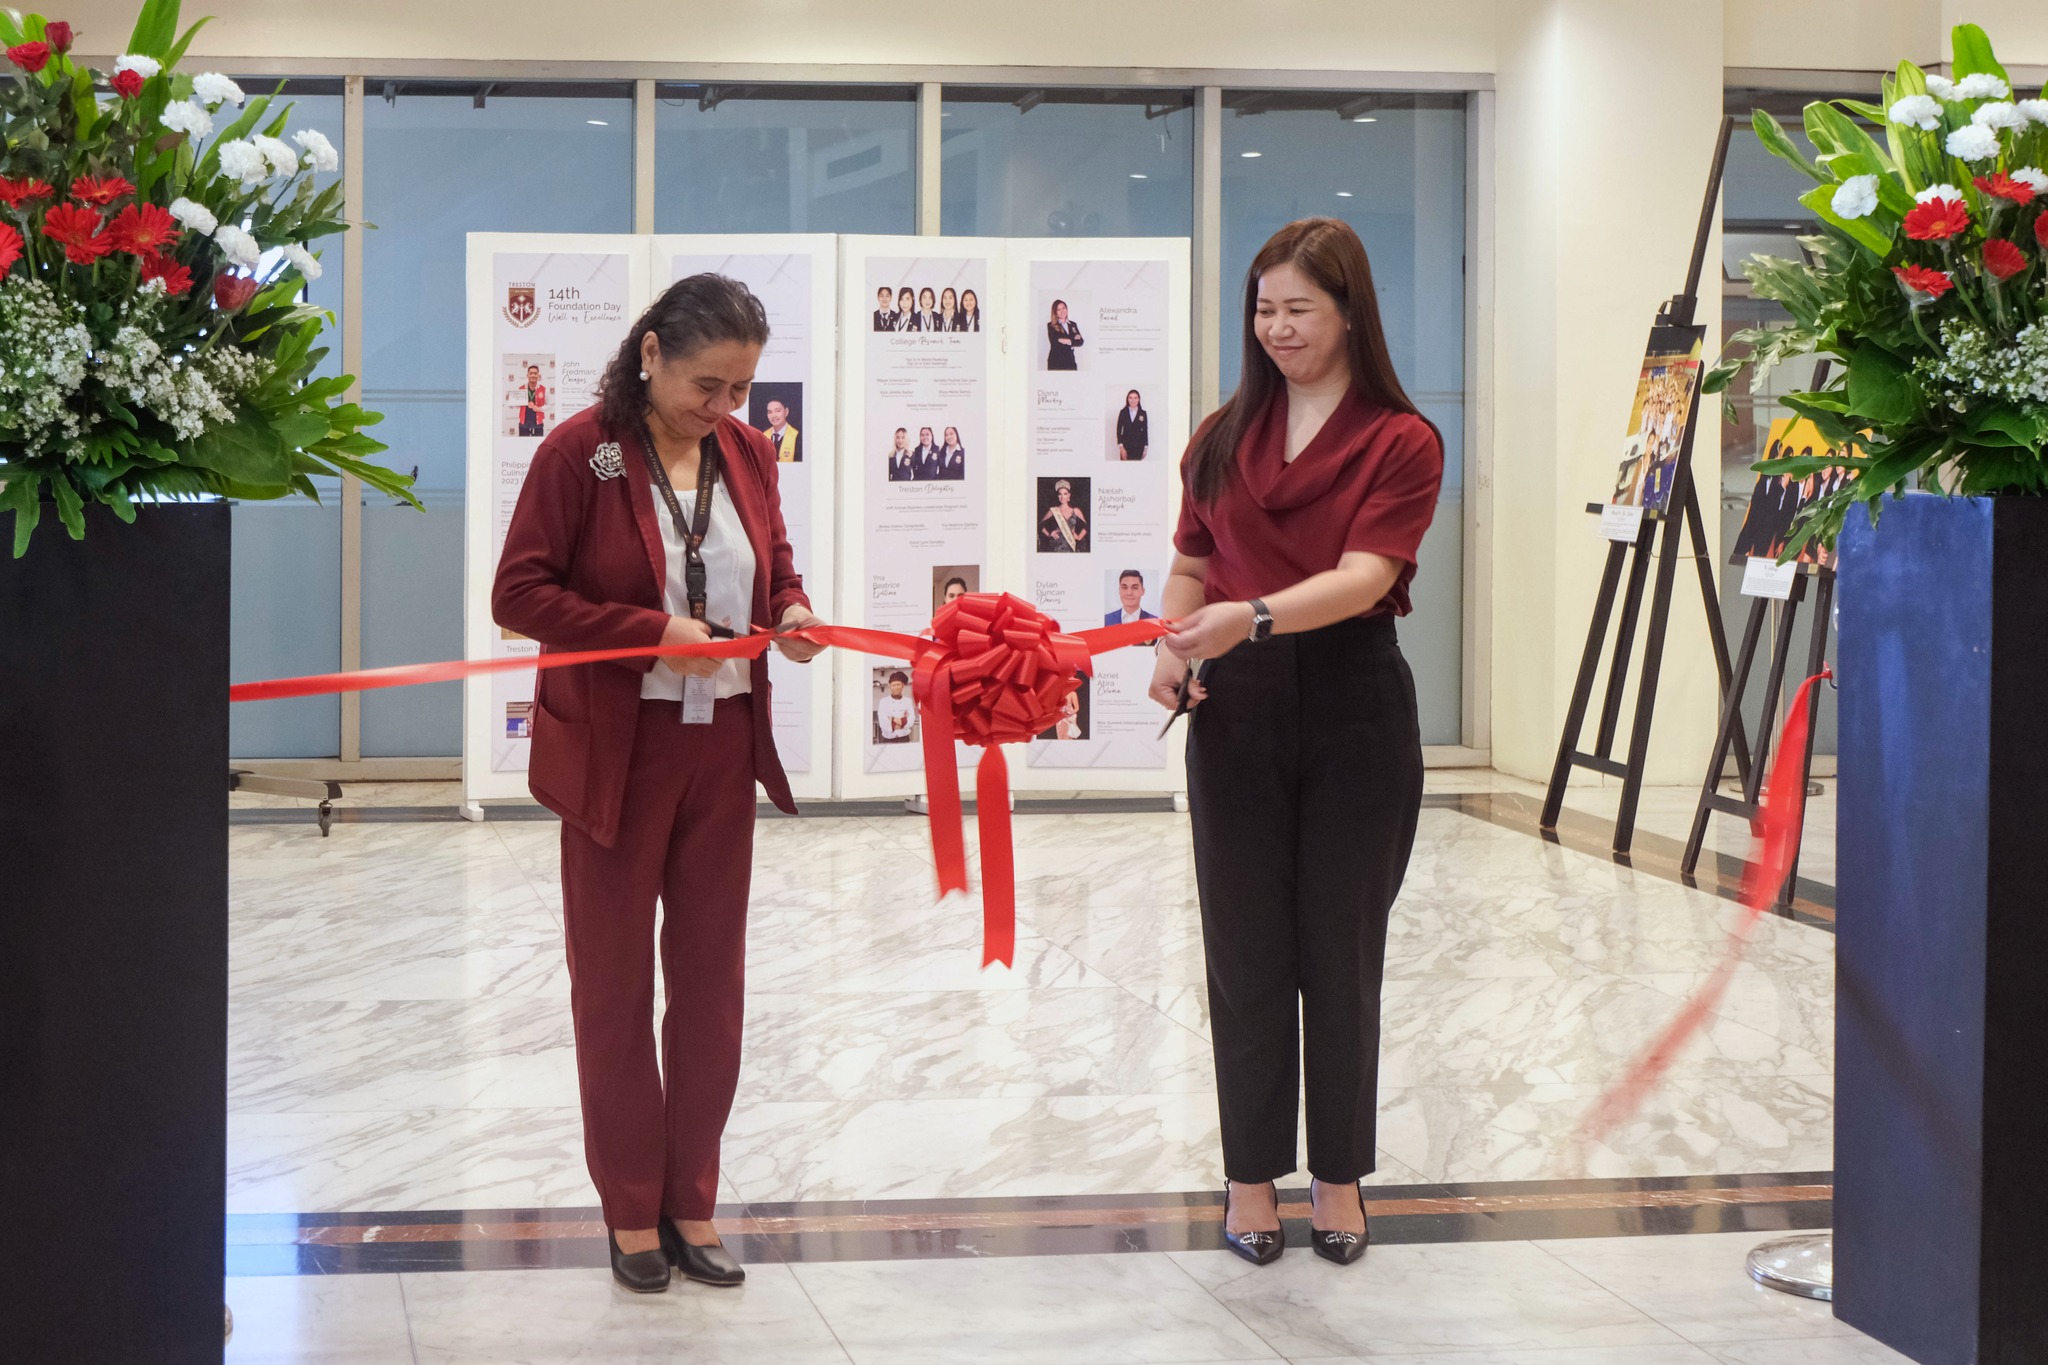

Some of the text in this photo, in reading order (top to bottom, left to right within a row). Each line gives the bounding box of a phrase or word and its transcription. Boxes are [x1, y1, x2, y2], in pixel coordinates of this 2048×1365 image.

[548, 287, 580, 301] 14th
[548, 302, 622, 312] Foundation Day
[548, 312, 567, 323] Wall
[584, 311, 622, 324] Excellence
[890, 338, 916, 346] College
[925, 484, 954, 494] Delegates
[663, 484, 679, 514] COLLEGE
[700, 489, 709, 515] TRESTON
[1036, 581, 1058, 589] Dylan
